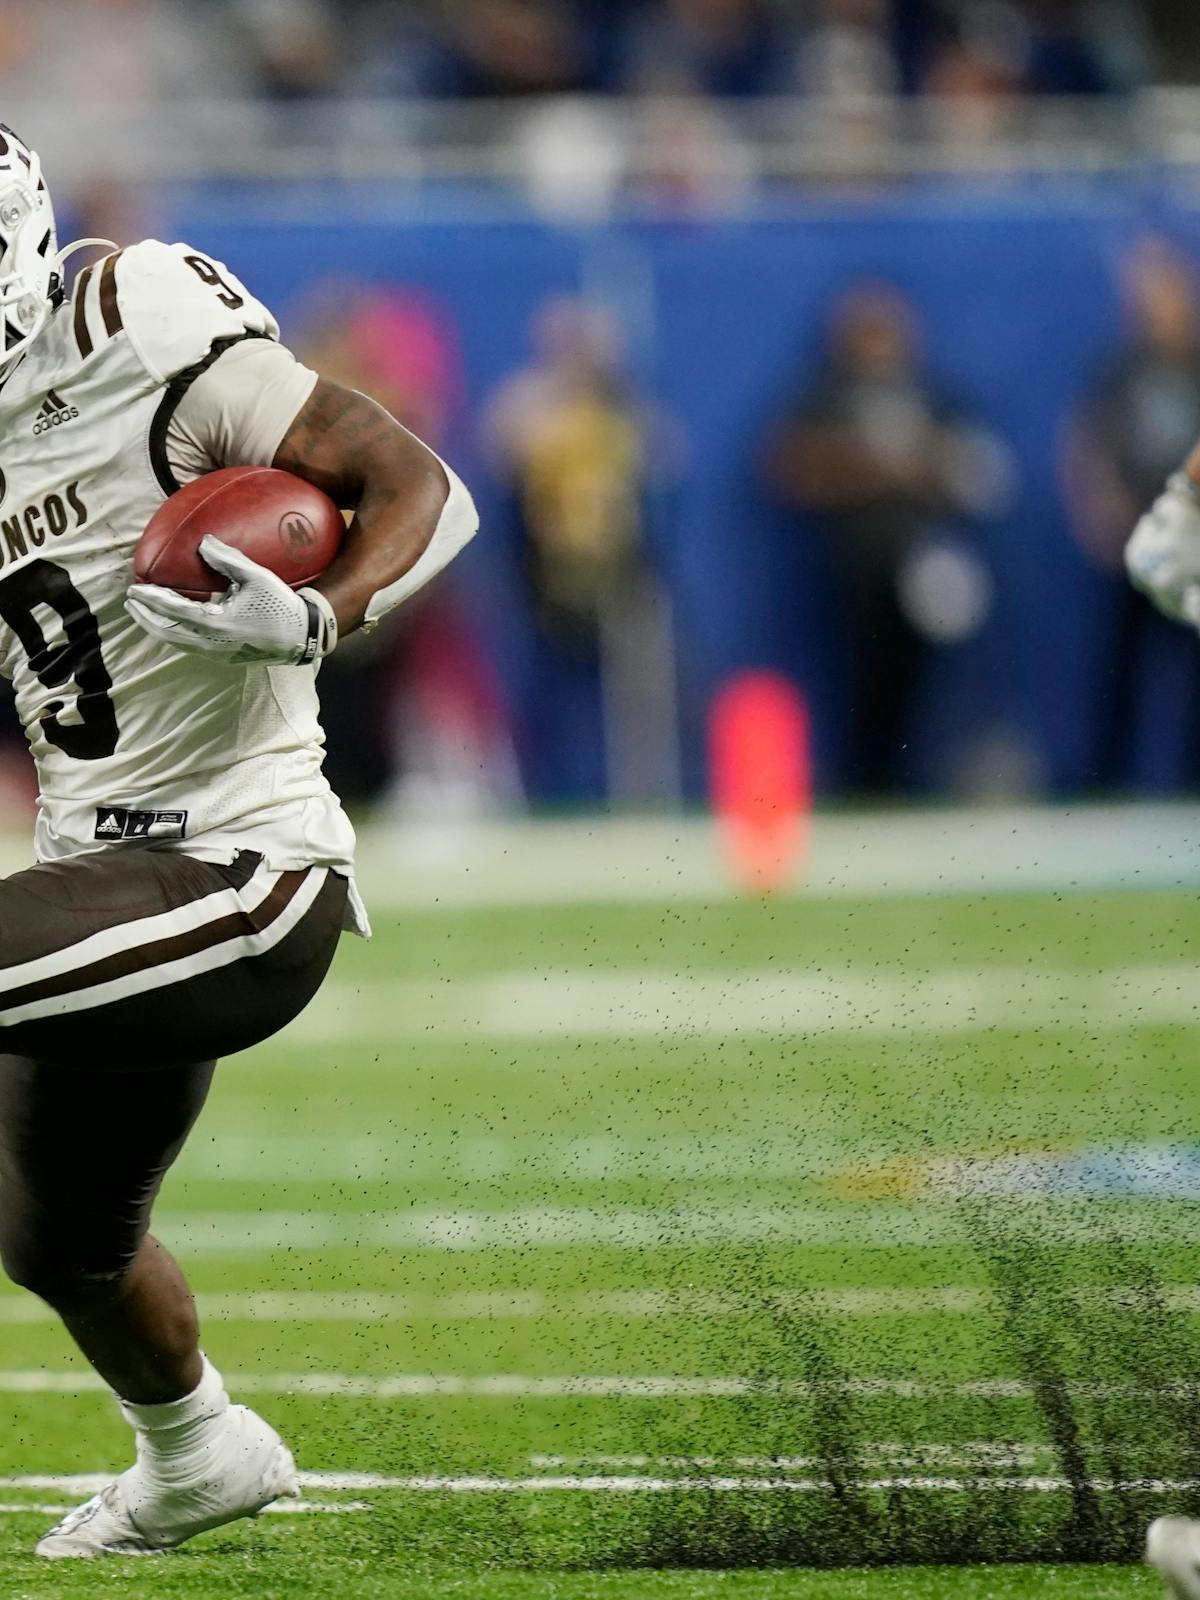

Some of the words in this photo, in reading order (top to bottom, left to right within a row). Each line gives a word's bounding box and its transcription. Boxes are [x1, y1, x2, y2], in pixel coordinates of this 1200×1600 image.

[183, 254, 244, 311] 9
[32, 405, 80, 436] adidas
[96, 825, 122, 834] adidas
